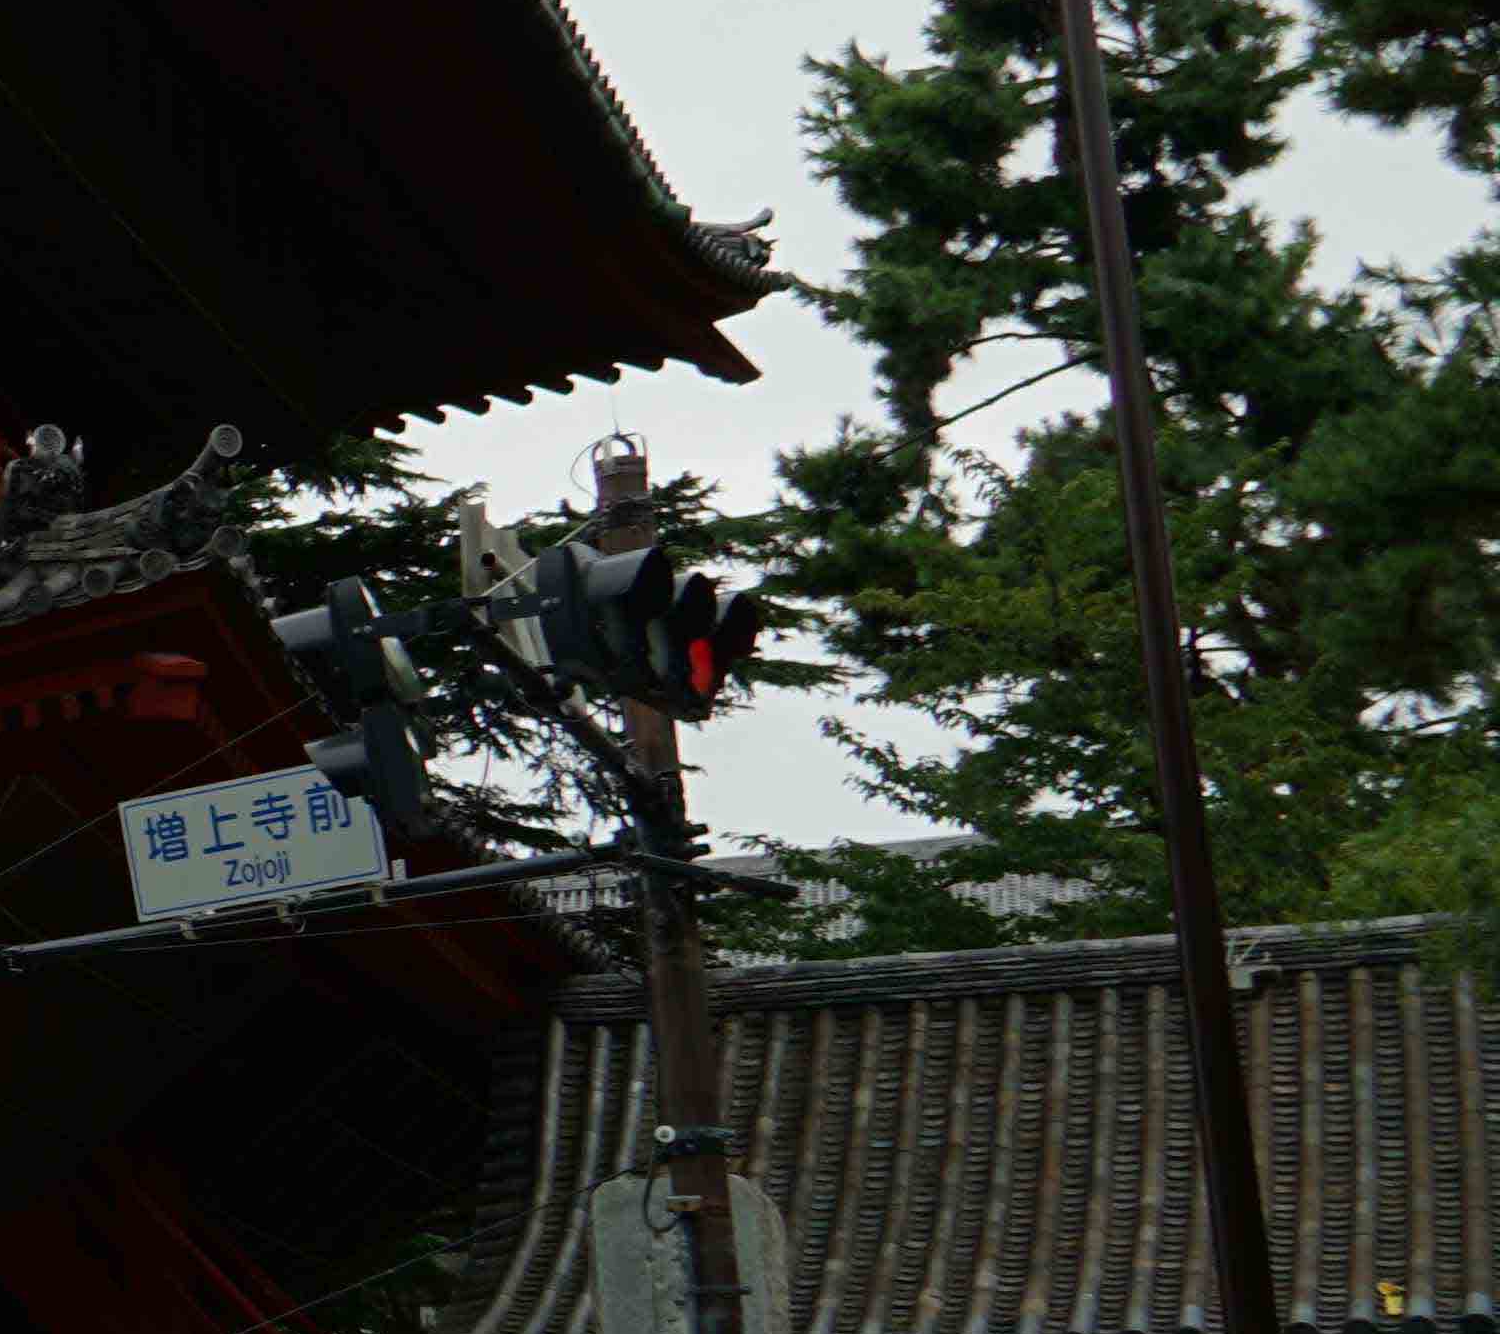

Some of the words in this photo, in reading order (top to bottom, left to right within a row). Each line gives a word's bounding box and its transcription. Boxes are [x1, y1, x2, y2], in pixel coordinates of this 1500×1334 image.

[143, 781, 352, 862] 増上寺前
[224, 851, 291, 888] Zojoji
